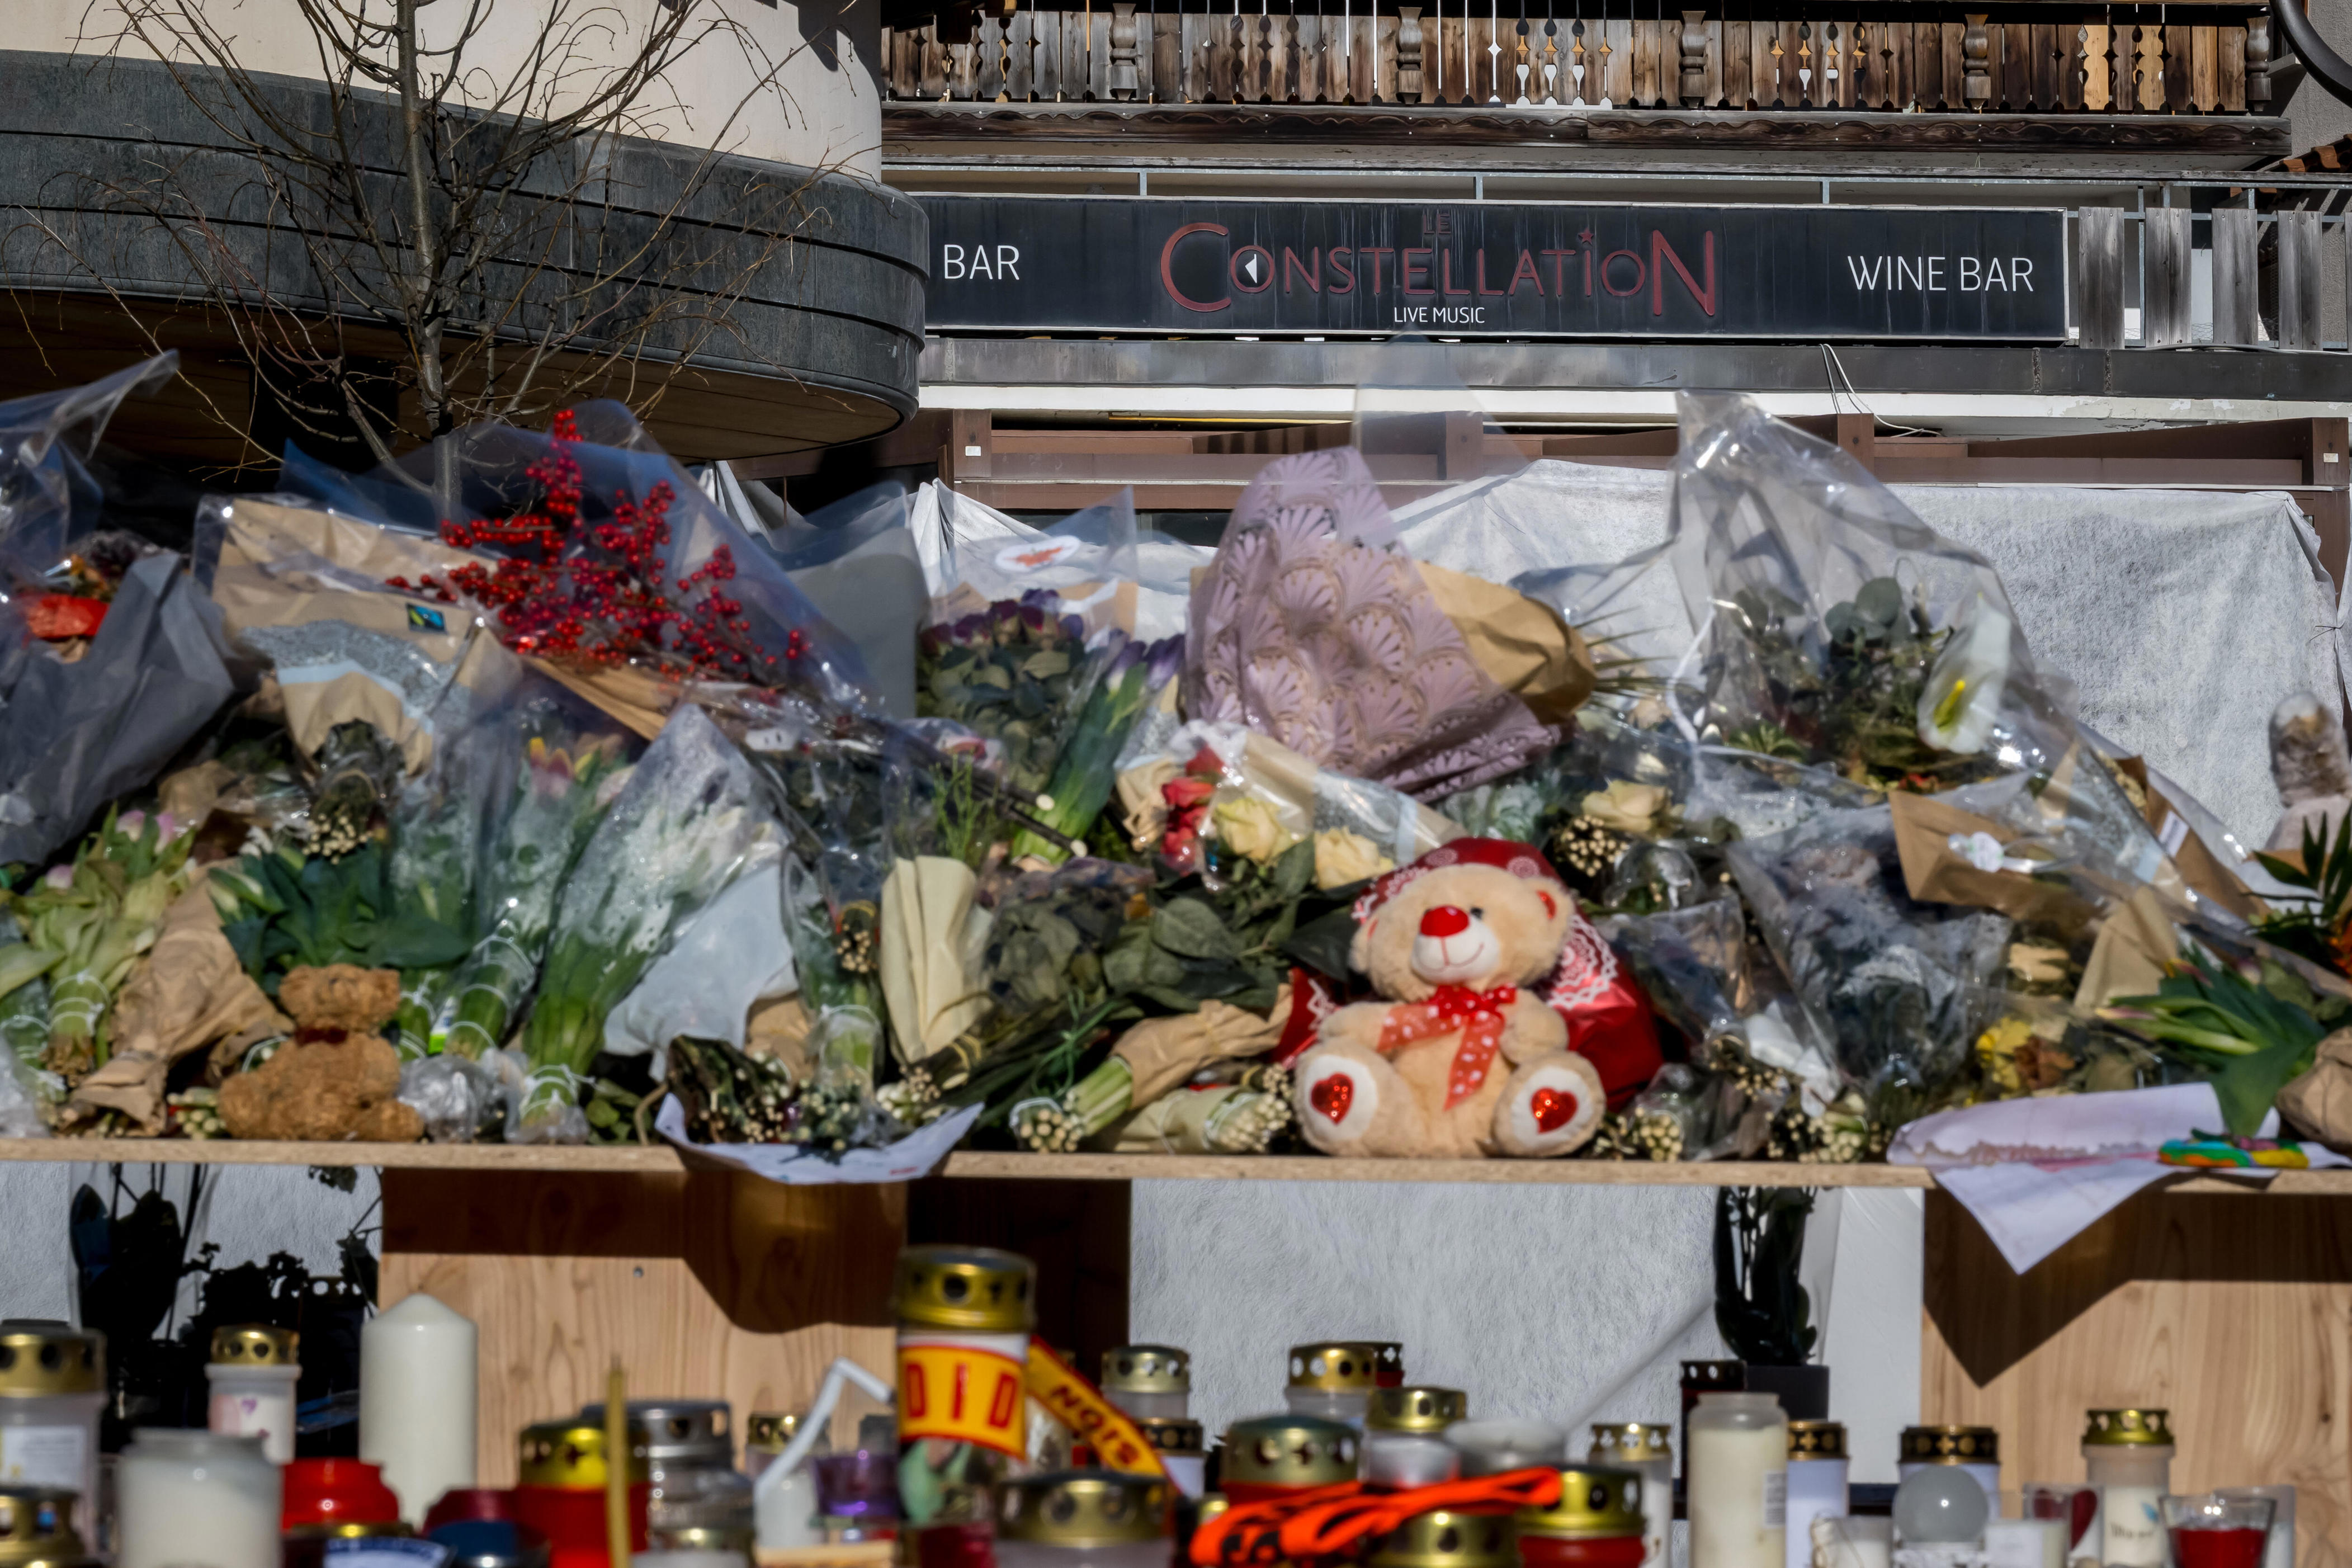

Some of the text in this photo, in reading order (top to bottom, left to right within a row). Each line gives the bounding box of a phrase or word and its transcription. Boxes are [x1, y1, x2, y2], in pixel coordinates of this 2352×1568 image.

[944, 244, 1019, 280] BAR
[1847, 256, 2034, 292] WINE BAR
[1394, 306, 1485, 324] LIVE MUSIC
